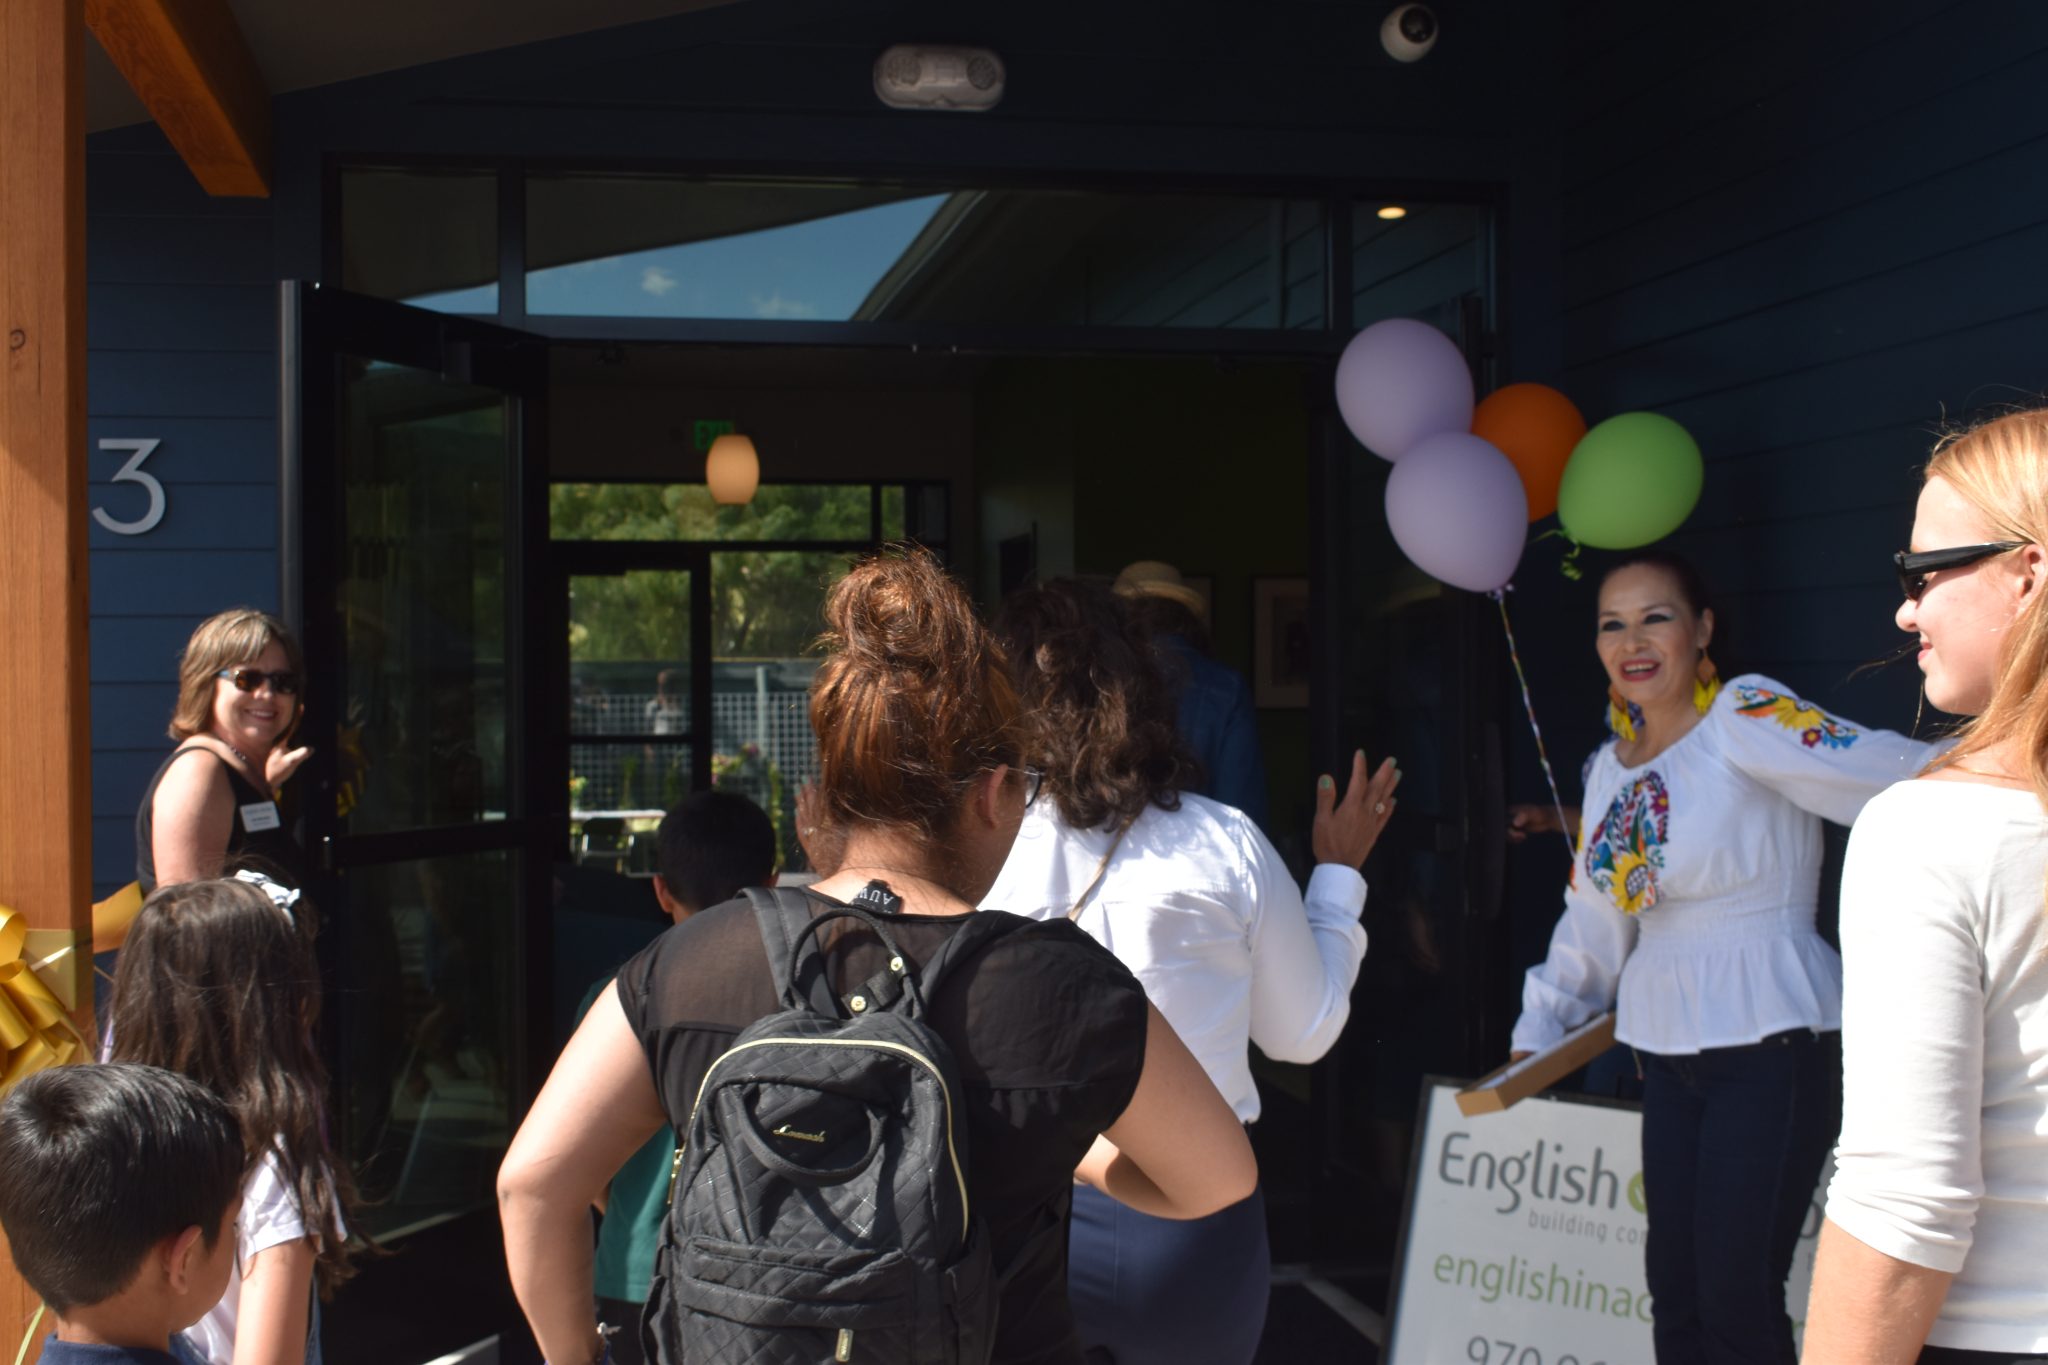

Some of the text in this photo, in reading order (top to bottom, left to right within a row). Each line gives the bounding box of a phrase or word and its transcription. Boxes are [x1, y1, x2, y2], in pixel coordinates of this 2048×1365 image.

[92, 438, 166, 535] 3
[1438, 1131, 1619, 1214] English
[1528, 1209, 1608, 1243] building
